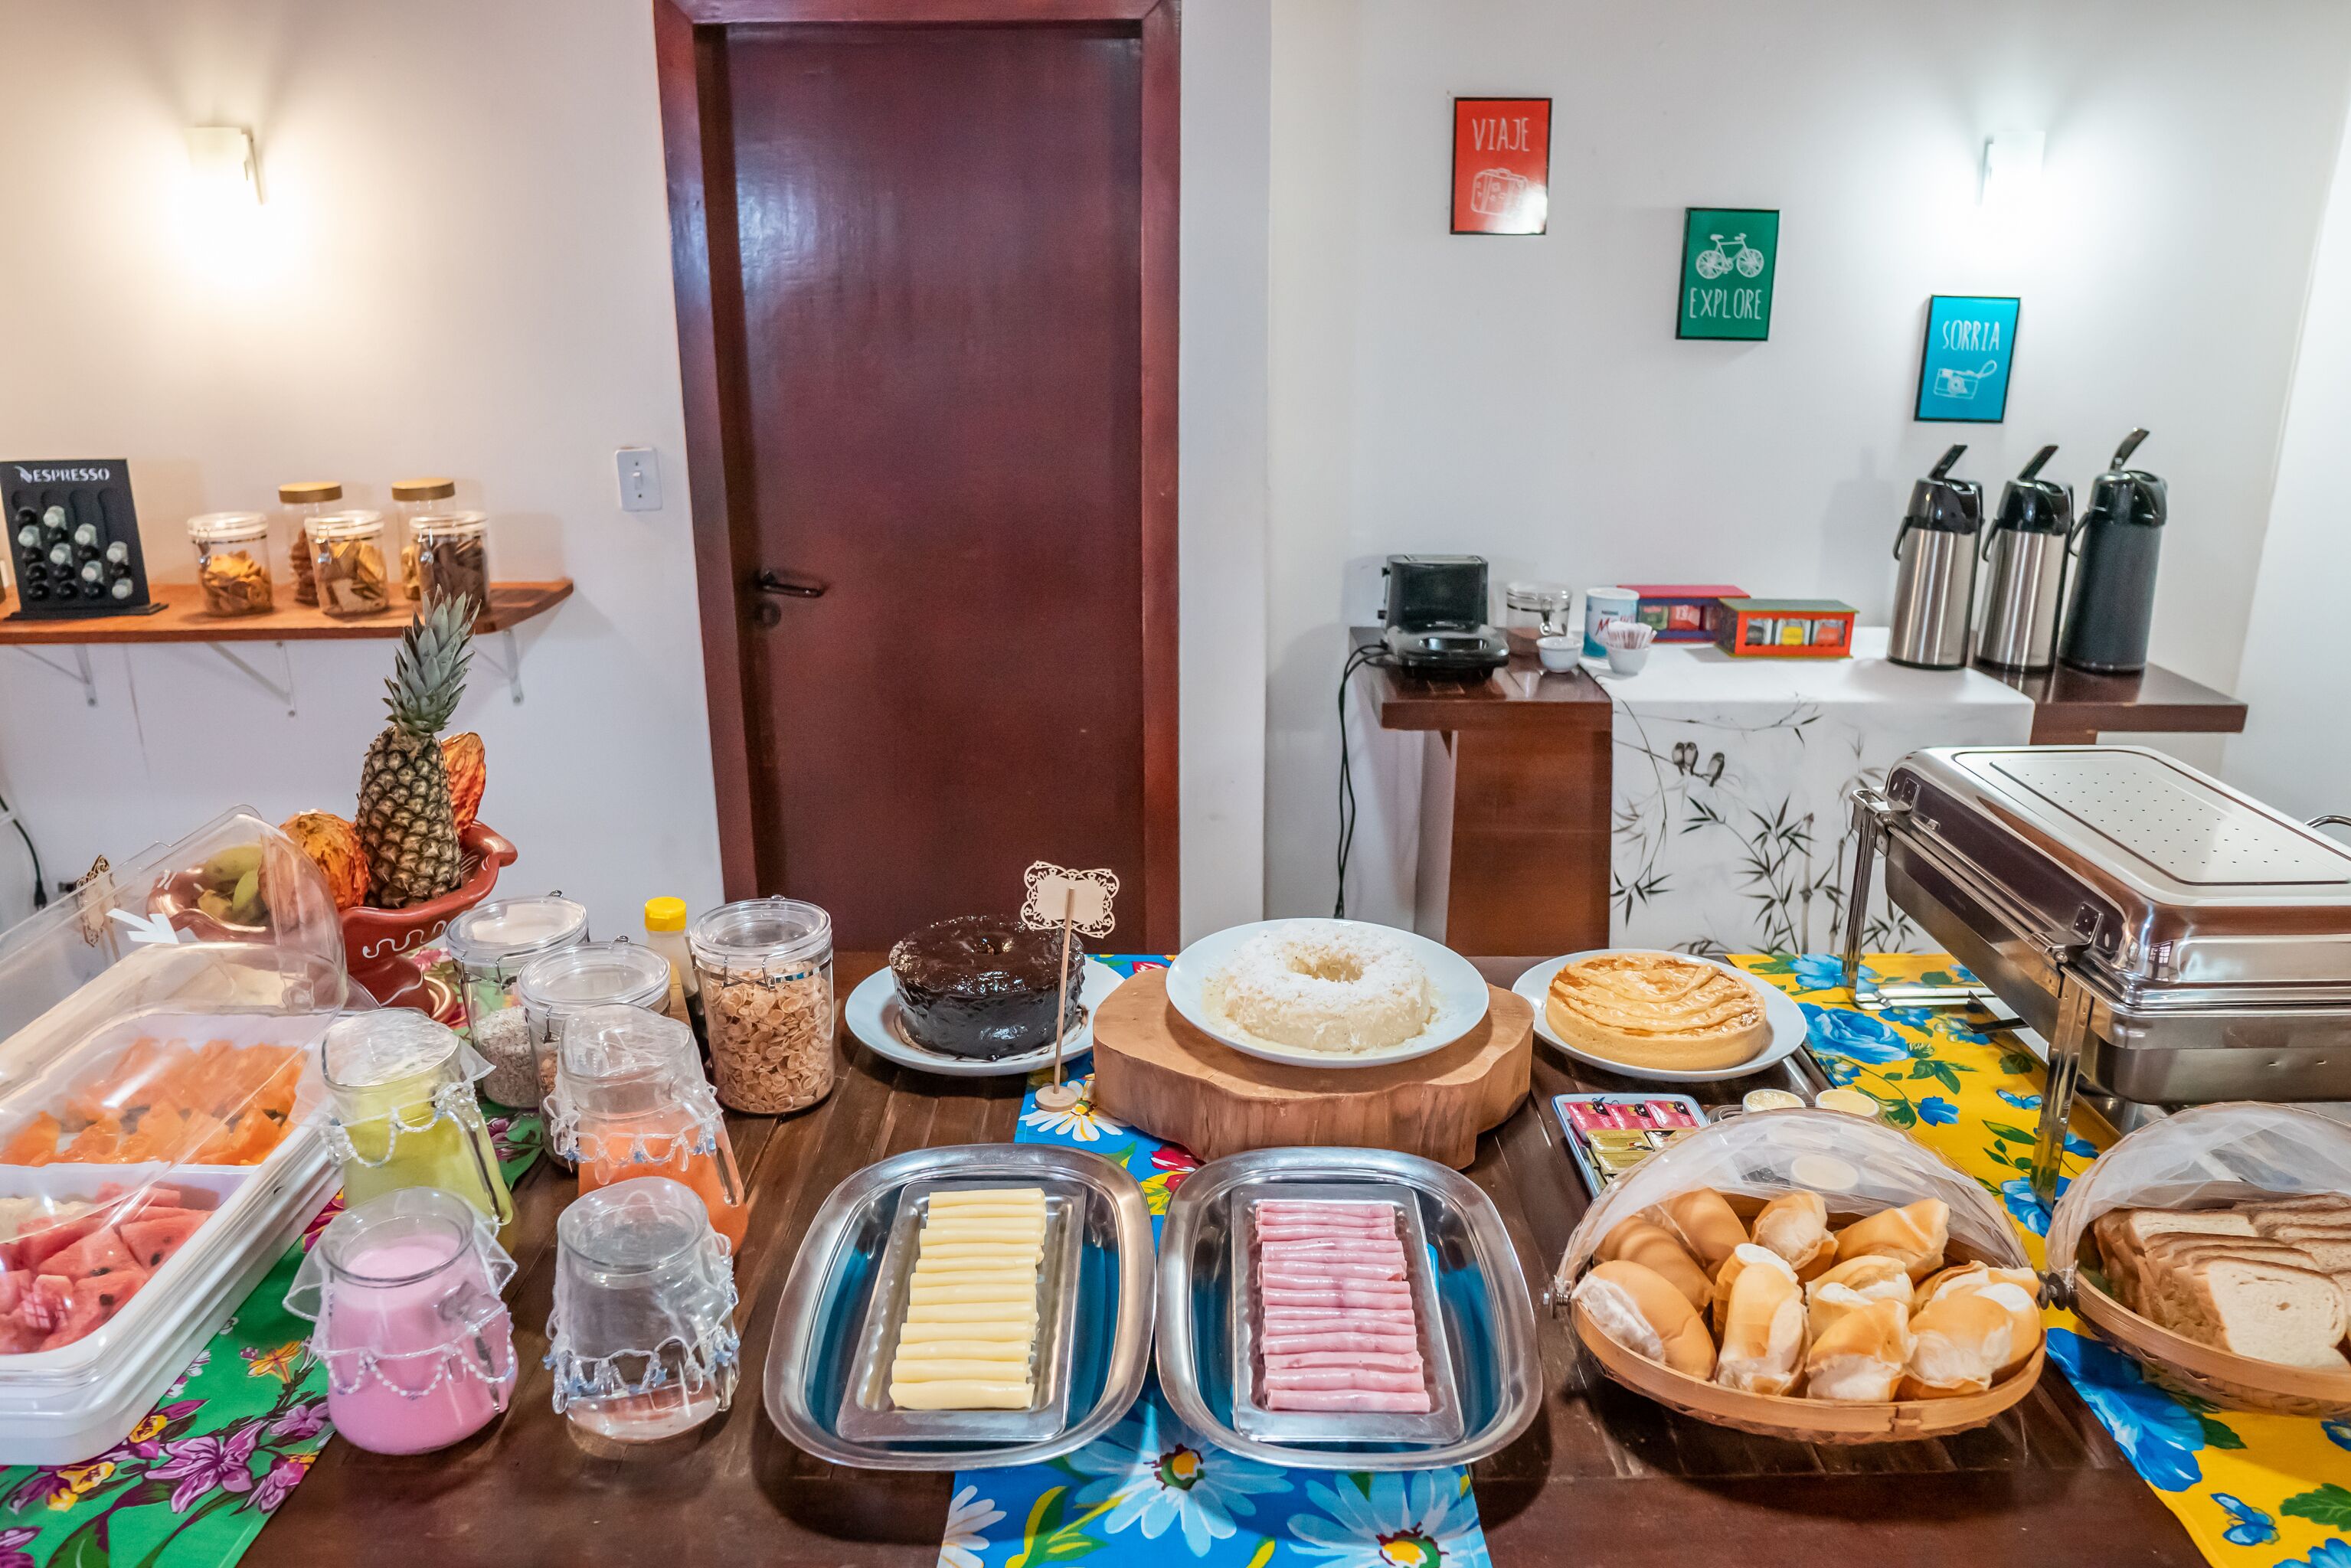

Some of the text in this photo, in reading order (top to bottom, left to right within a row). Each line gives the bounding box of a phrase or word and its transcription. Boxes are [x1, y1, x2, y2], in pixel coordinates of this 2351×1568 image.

[1472, 117, 1531, 152] VIAJE
[1689, 286, 1762, 320] EXPLORE
[1942, 319, 2000, 351] SORRIA
[14, 465, 110, 484] NESPRESSO
